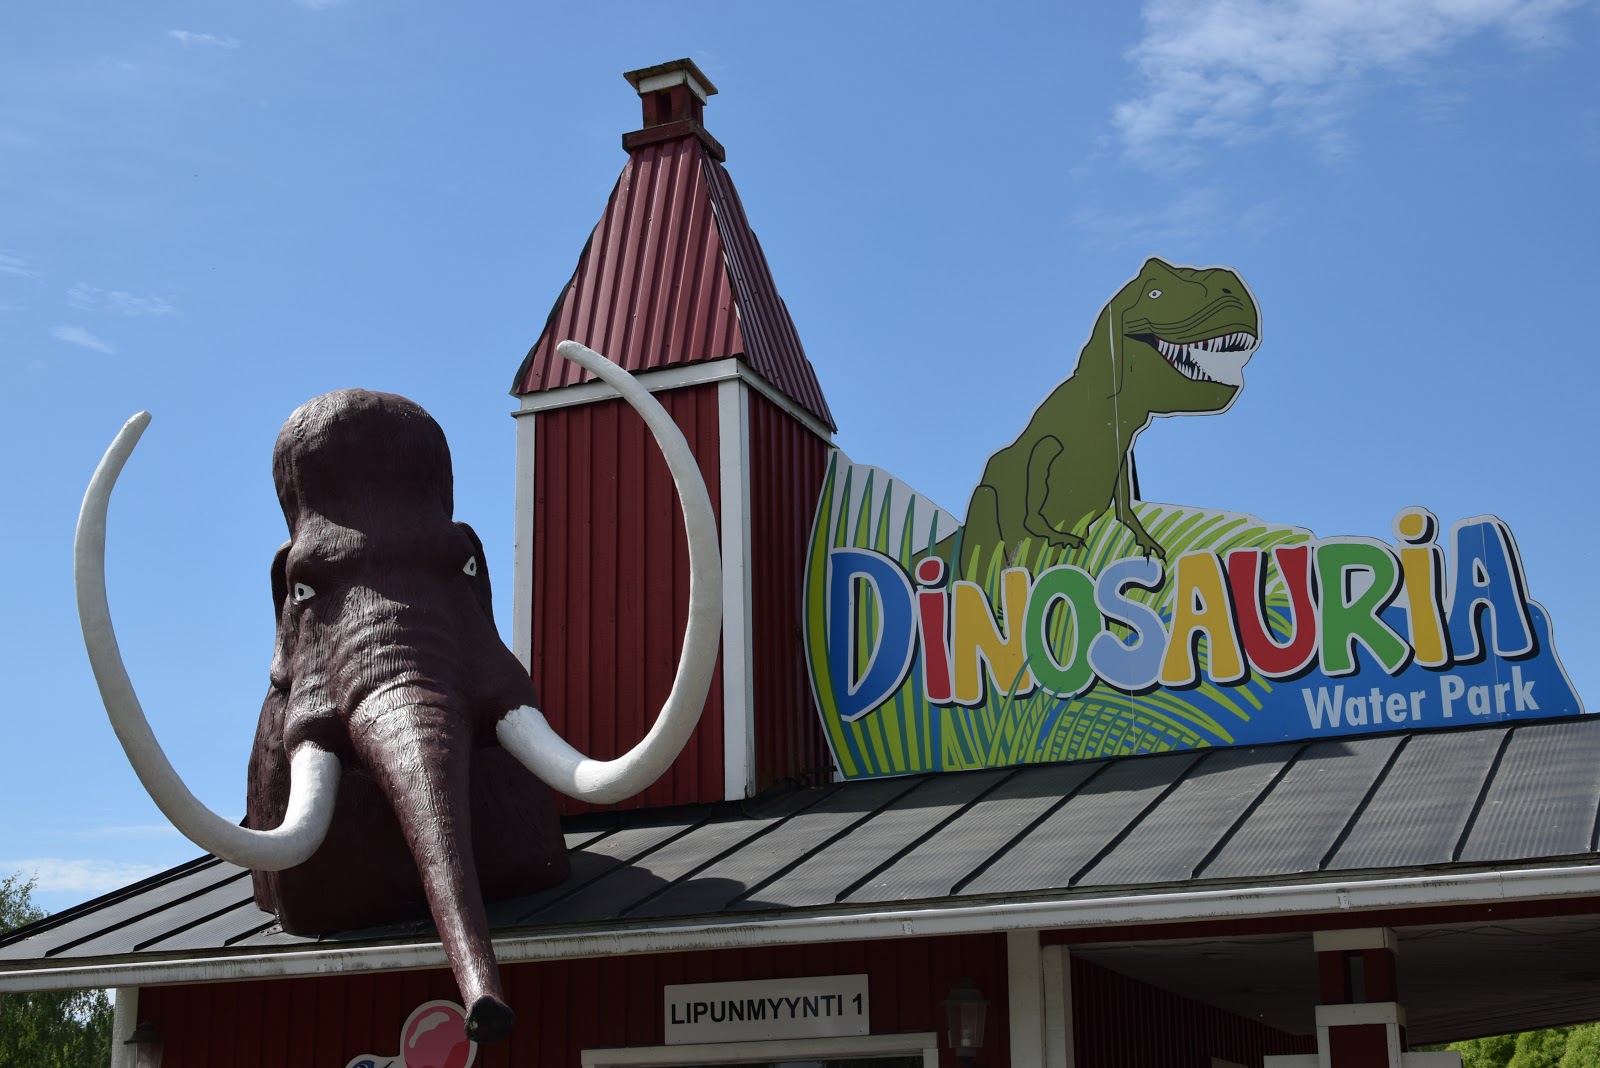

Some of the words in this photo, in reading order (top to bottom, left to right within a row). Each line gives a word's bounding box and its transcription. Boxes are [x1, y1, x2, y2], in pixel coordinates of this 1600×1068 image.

[1301, 684, 1426, 730] Water
[1439, 665, 1540, 718] Park
[671, 994, 843, 1025] LIPUNMYYNTI
[852, 993, 863, 1015] 1
